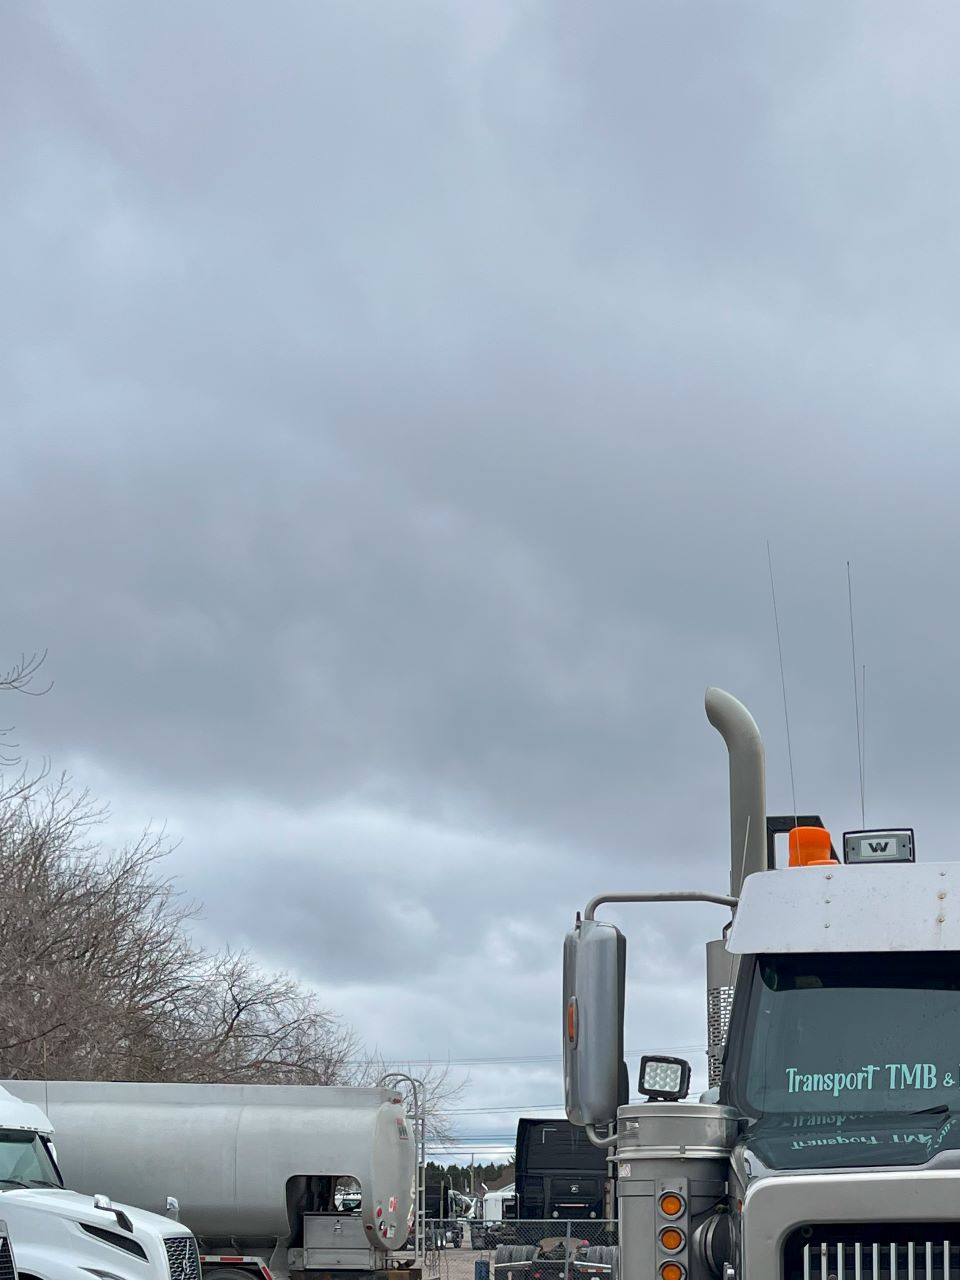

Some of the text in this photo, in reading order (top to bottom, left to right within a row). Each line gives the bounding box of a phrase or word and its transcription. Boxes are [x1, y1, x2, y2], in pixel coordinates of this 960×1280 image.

[786, 1064, 880, 1097] Transport
[885, 1063, 937, 1090] TMB
[942, 1072, 955, 1087] &
